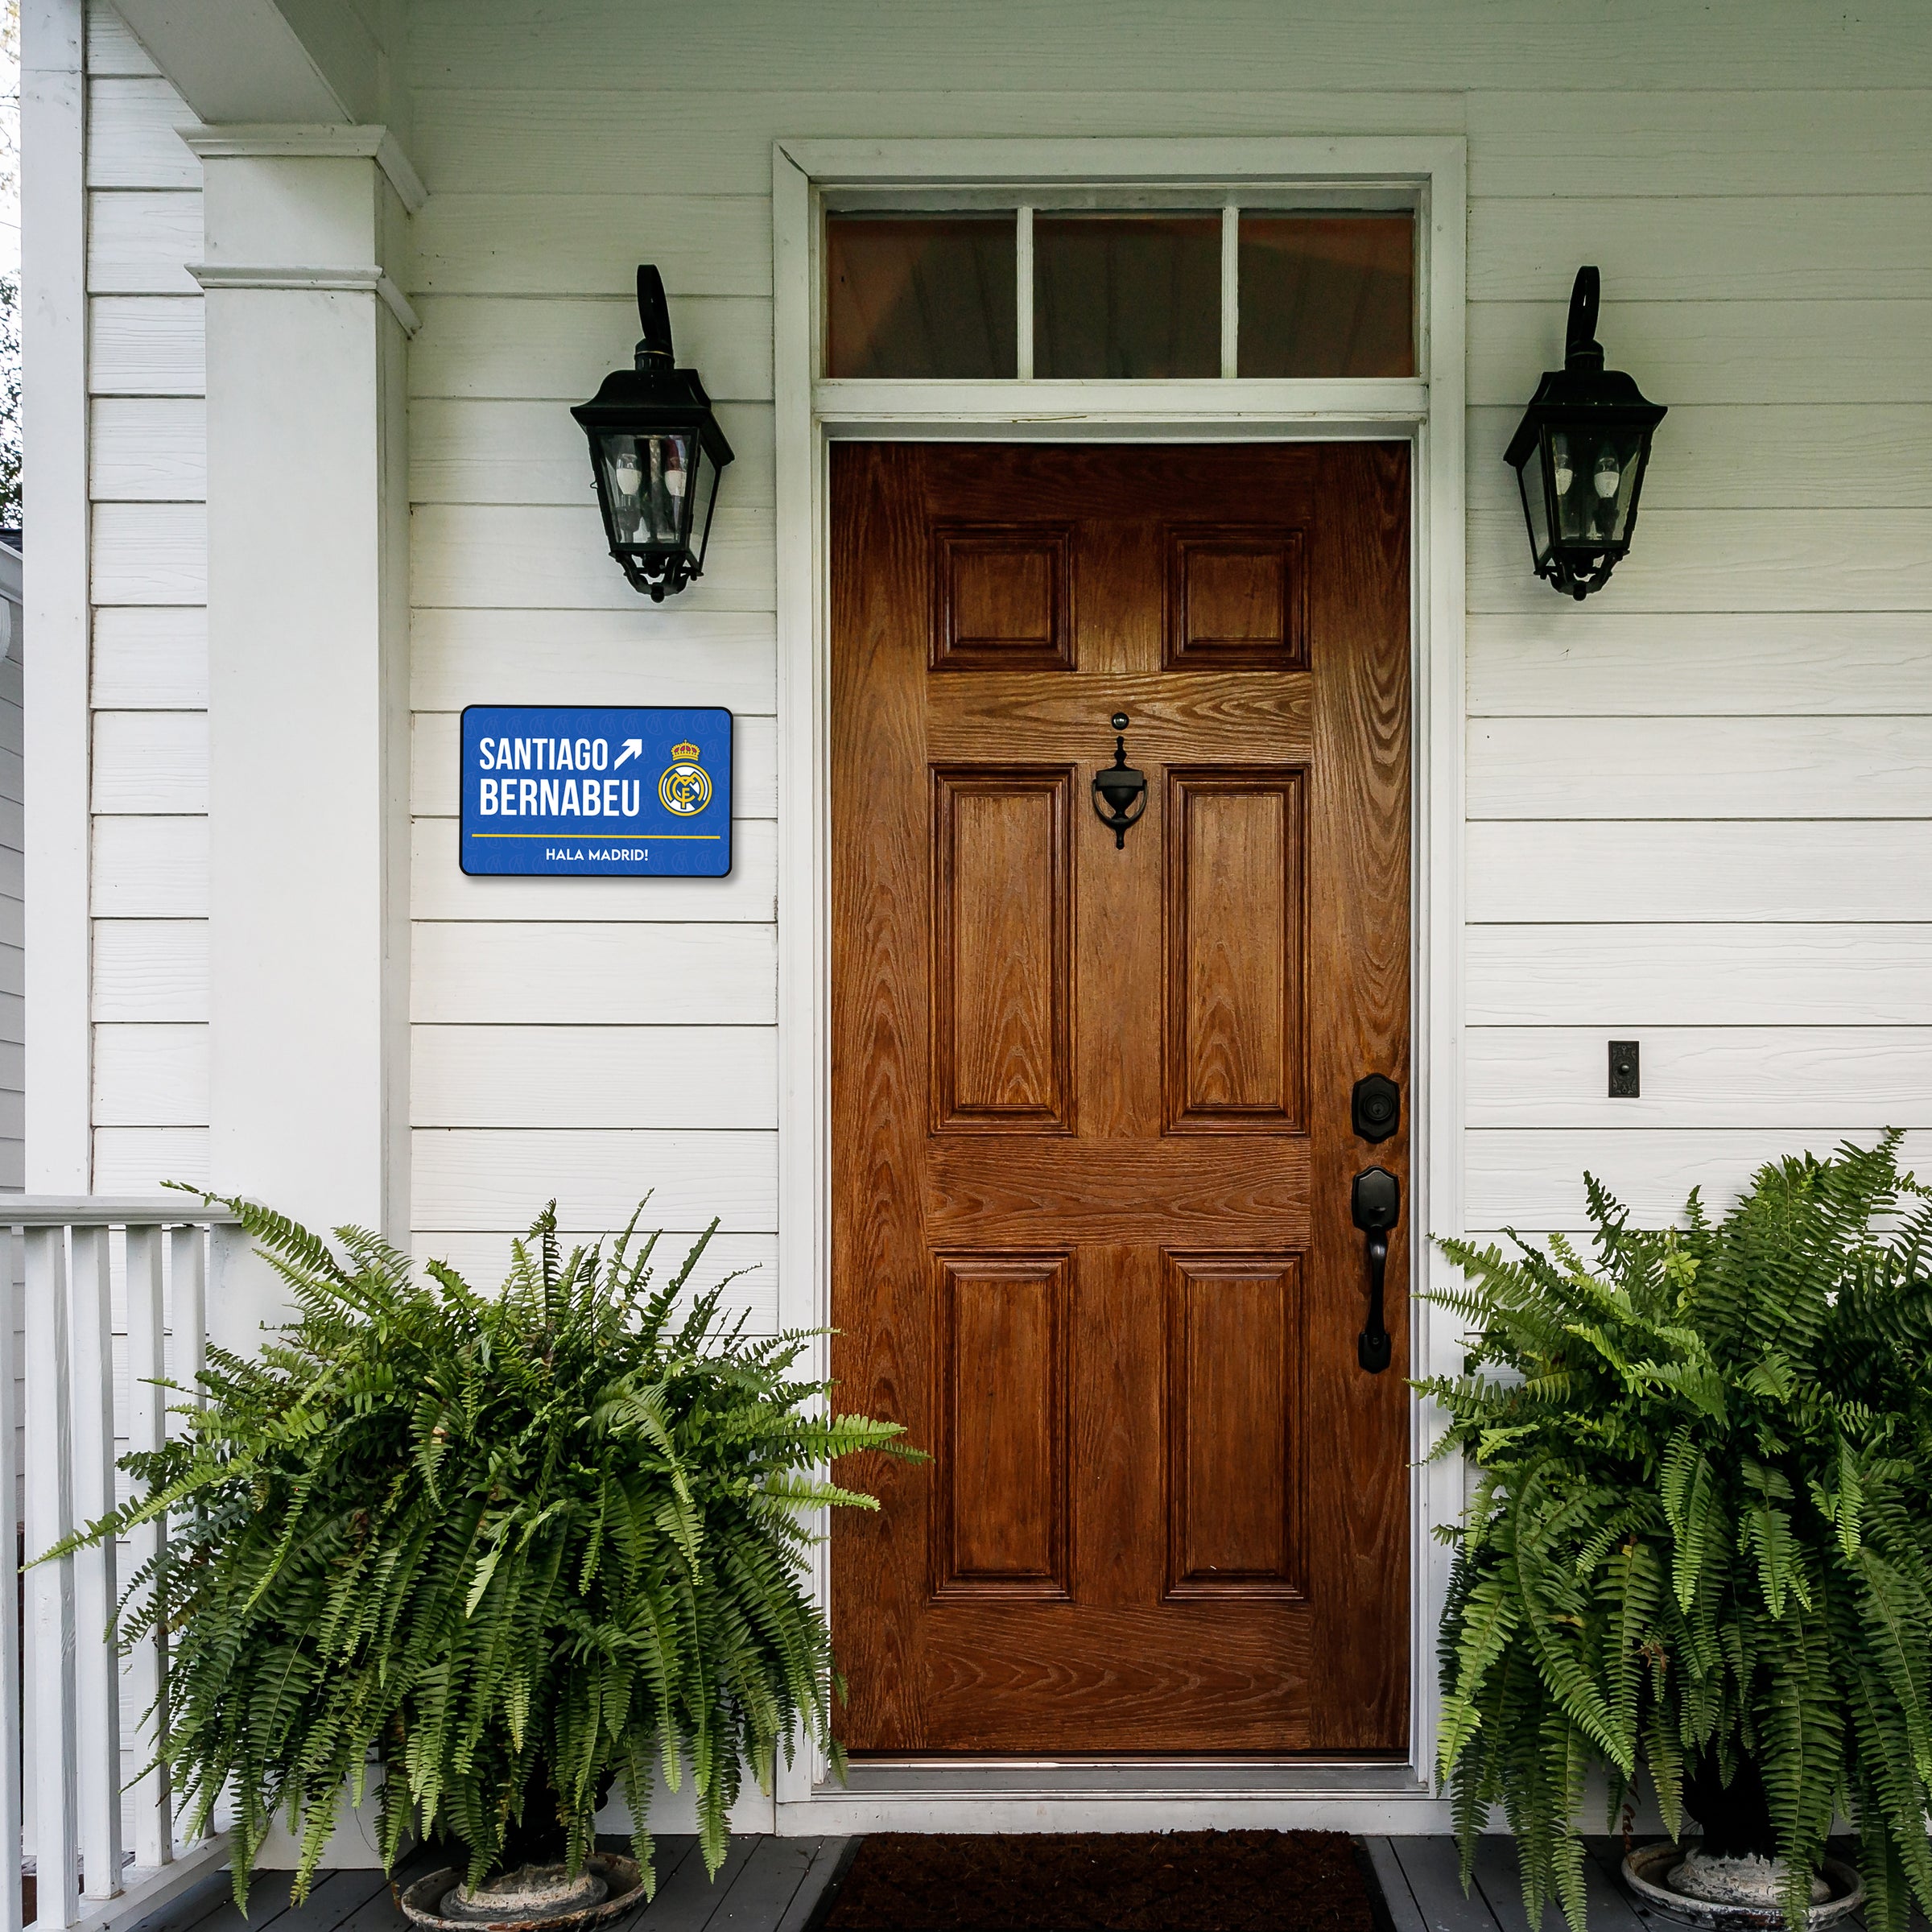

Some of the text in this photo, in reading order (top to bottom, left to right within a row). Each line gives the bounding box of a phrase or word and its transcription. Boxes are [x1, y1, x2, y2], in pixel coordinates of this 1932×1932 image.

[479, 737, 609, 771] SANTIAGO
[480, 778, 640, 817] BERNABEU
[546, 848, 649, 861] HALA MADRID!
